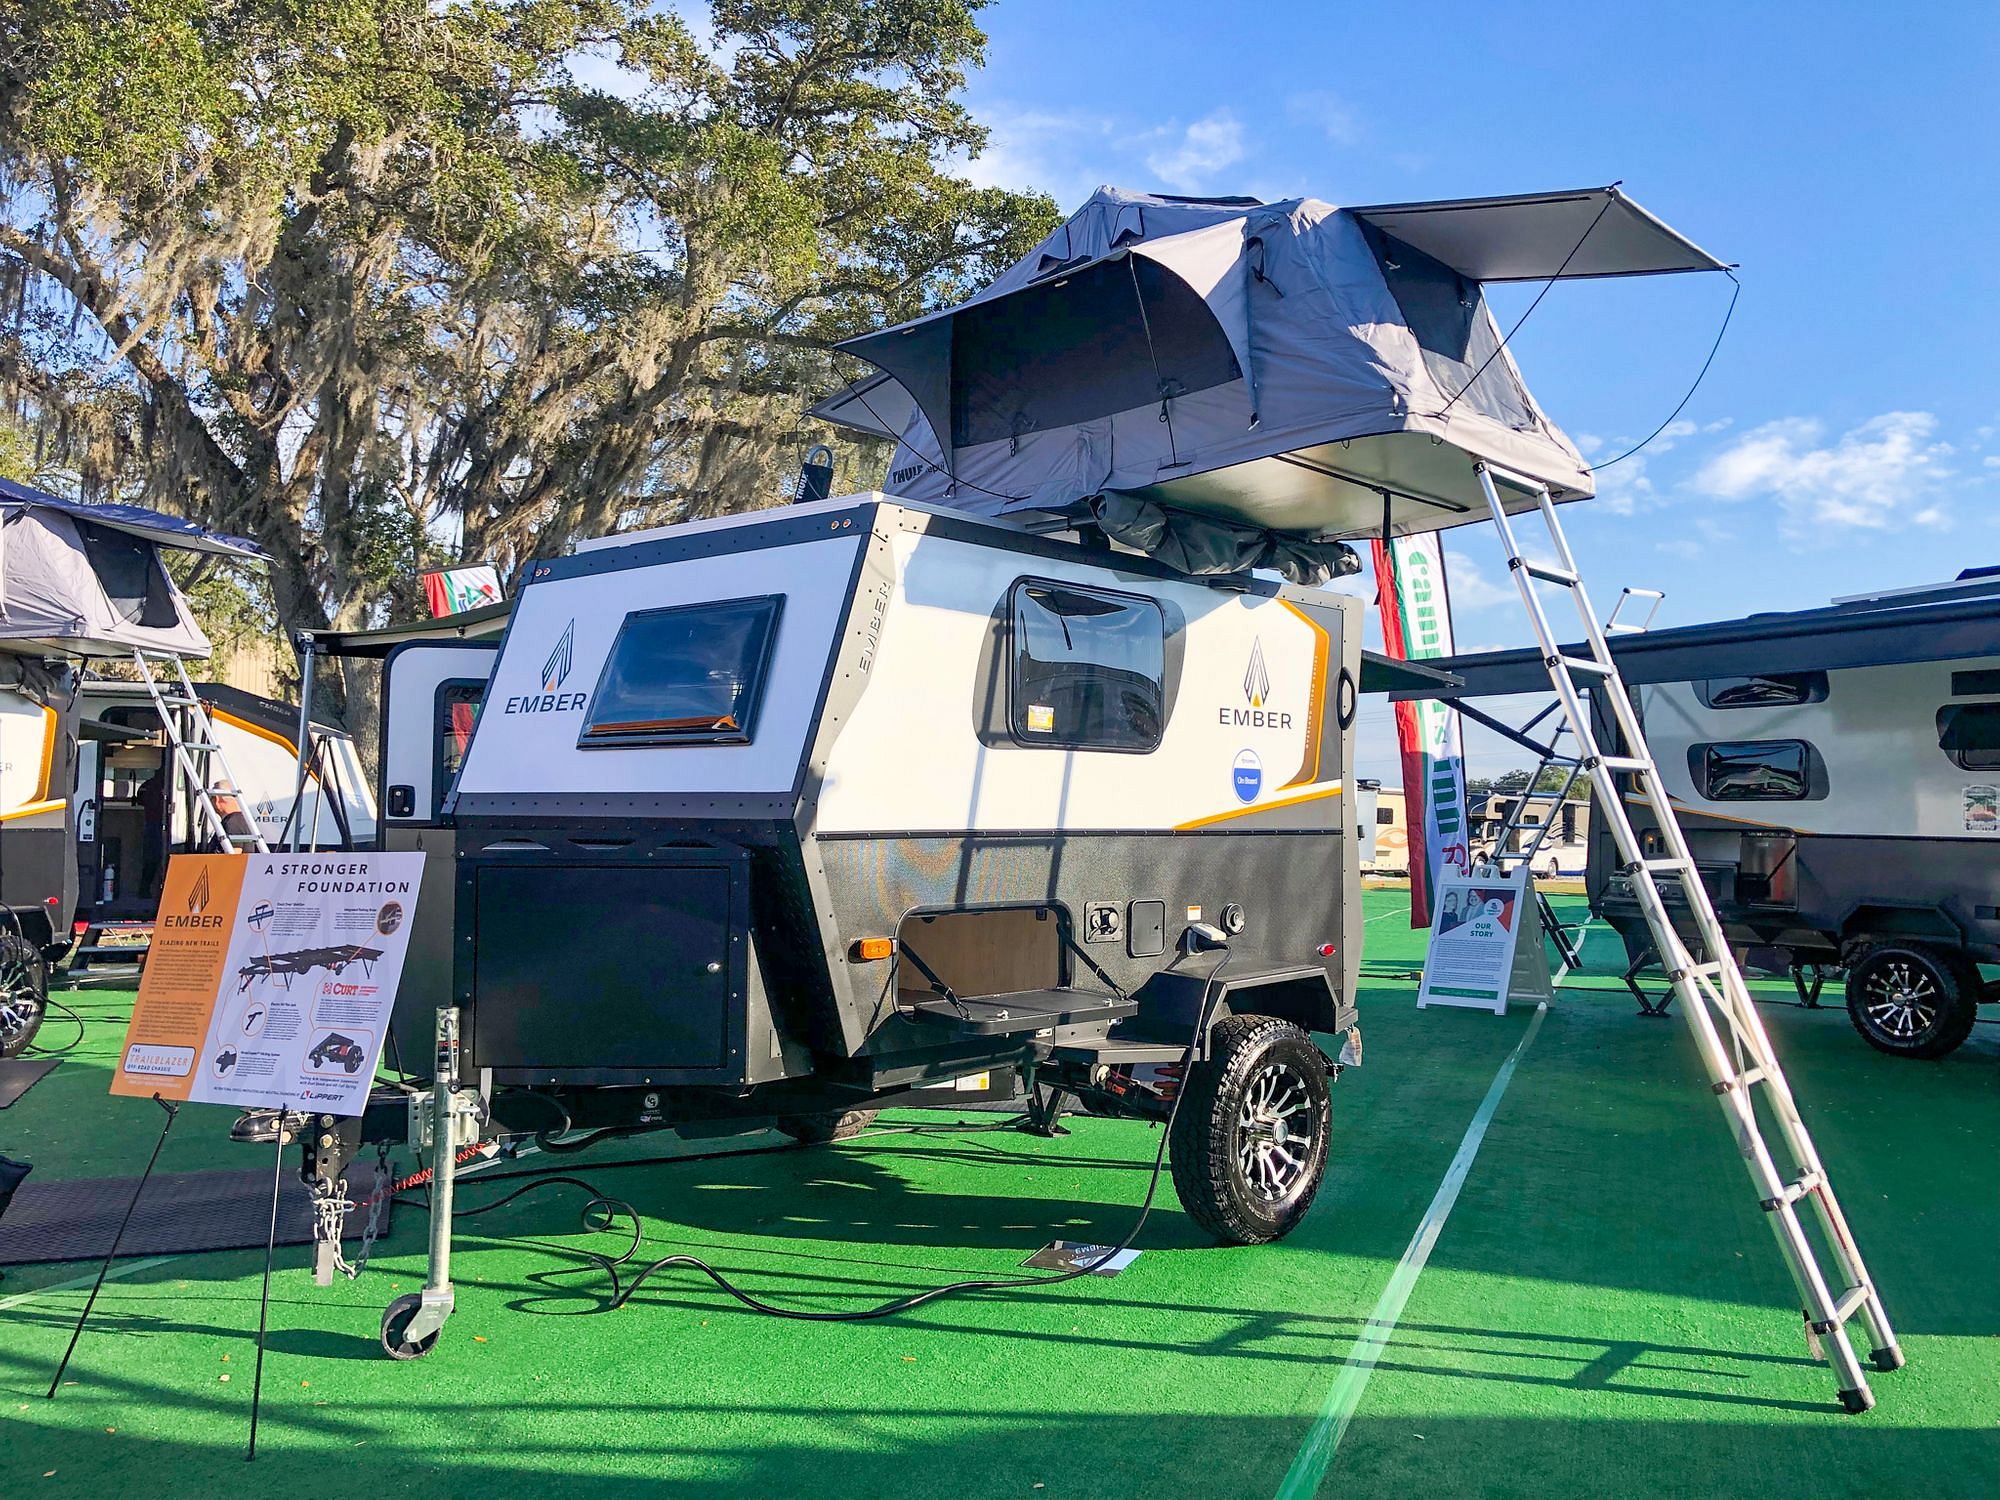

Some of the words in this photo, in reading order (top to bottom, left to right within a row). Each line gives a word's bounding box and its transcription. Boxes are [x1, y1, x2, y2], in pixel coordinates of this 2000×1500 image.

[859, 581, 891, 674] EMBER
[504, 692, 587, 714] EMBER
[1219, 707, 1292, 729] EMBER
[264, 864, 274, 875] A
[281, 864, 368, 875] STRONGER
[297, 882, 410, 893] FOUNDATION
[164, 915, 223, 928] EMBER
[1475, 922, 1491, 930] OUR
[1470, 930, 1494, 938] STORY
